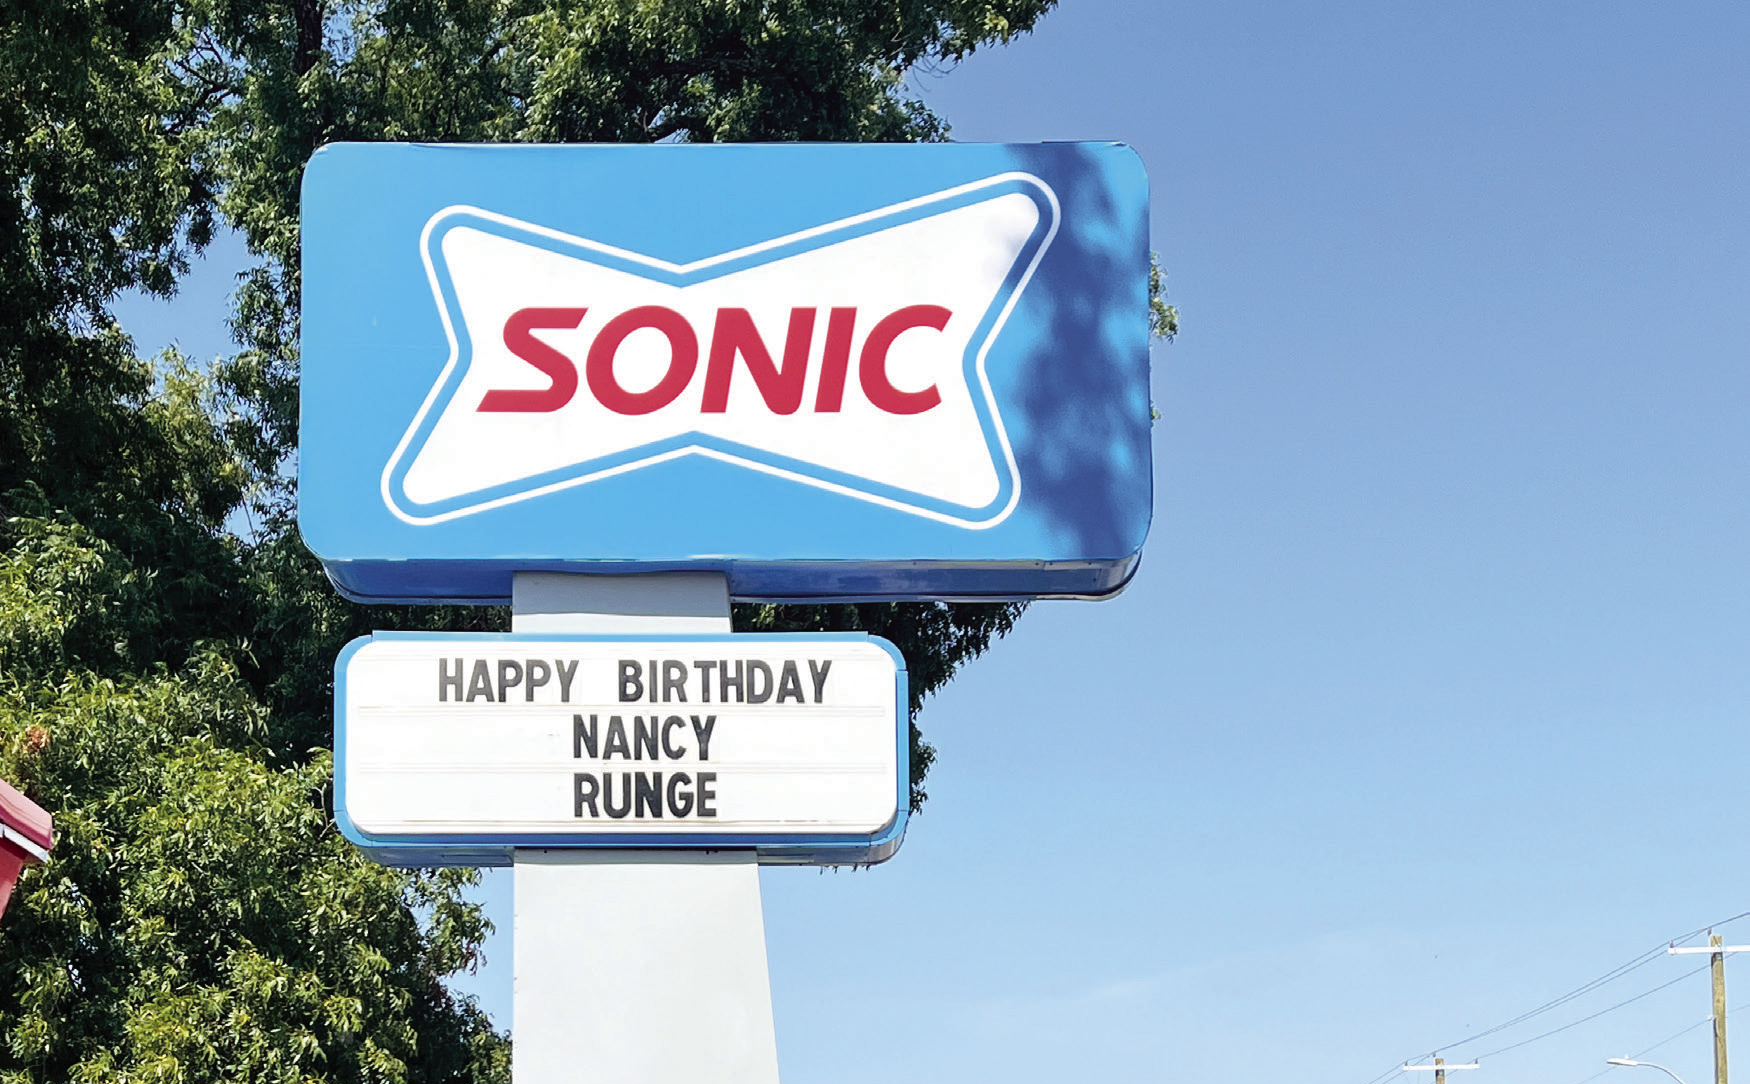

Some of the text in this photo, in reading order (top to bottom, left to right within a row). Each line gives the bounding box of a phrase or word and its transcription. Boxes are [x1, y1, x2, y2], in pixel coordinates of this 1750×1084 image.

[477, 305, 952, 415] SONIC
[440, 660, 831, 703] HAPPY BIRTHDAY
[574, 715, 716, 760] NANCY
[574, 772, 716, 818] RUNGE
